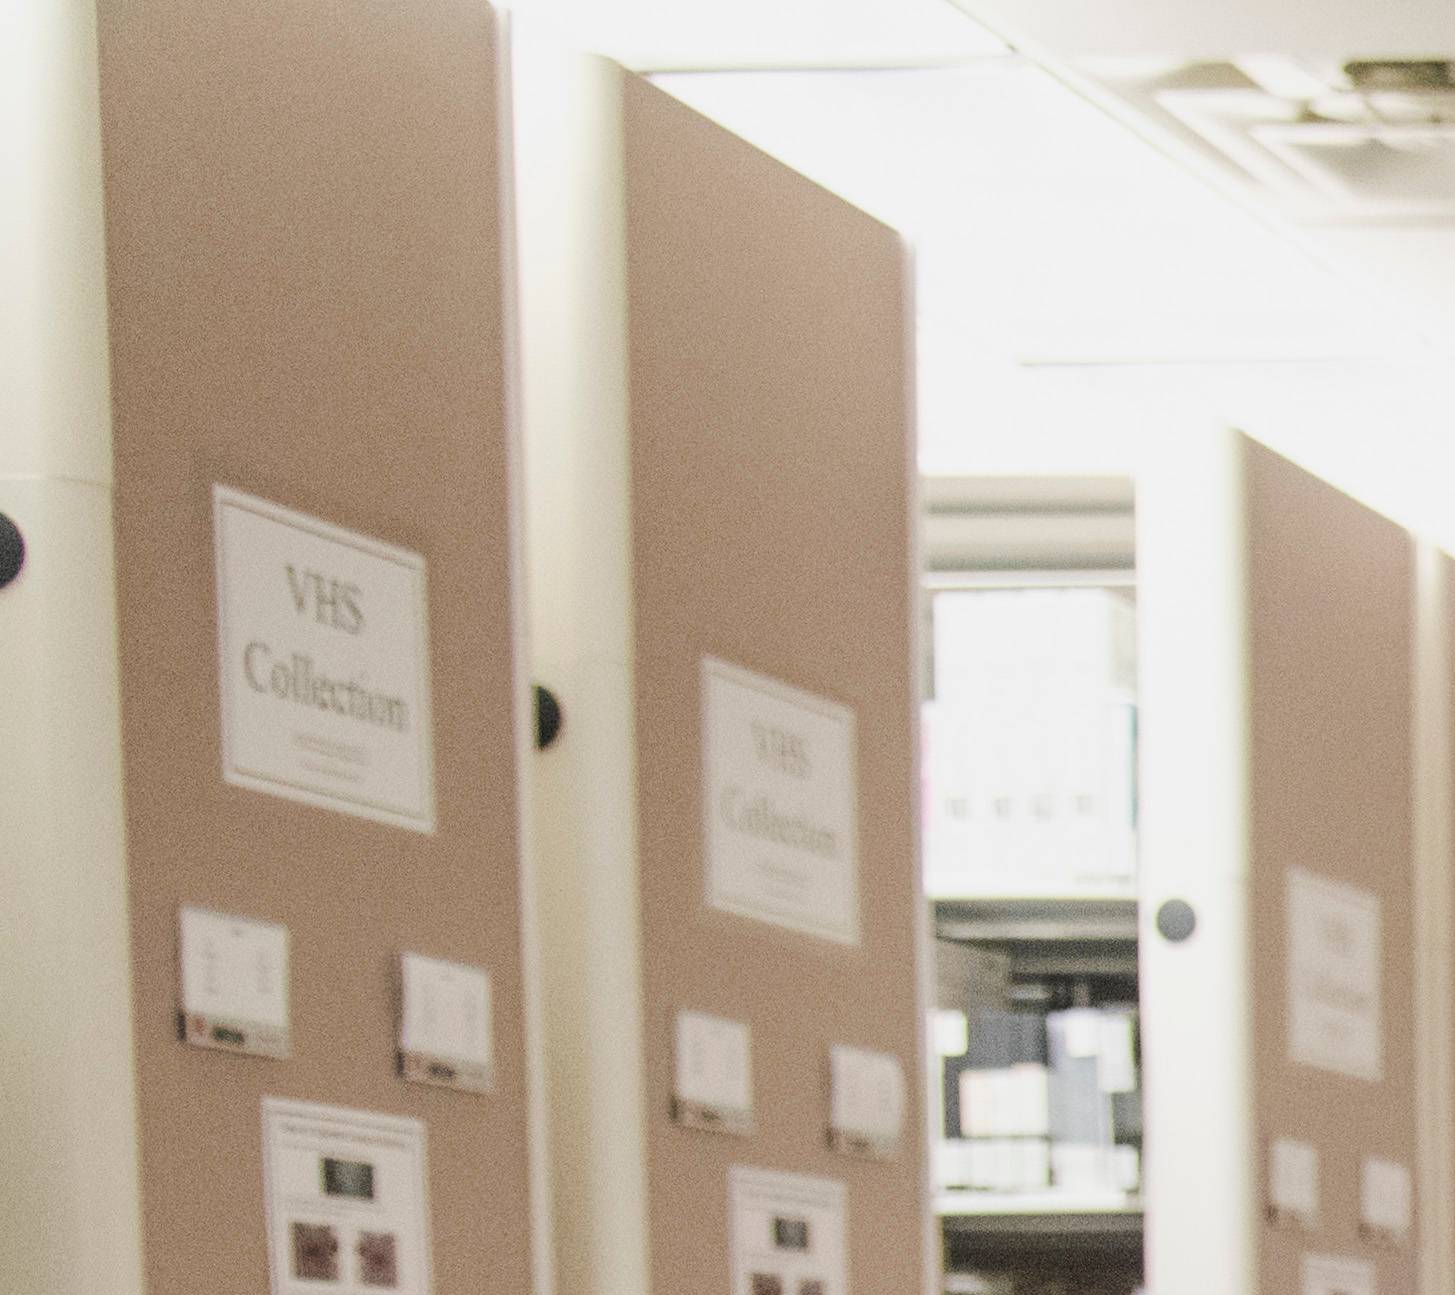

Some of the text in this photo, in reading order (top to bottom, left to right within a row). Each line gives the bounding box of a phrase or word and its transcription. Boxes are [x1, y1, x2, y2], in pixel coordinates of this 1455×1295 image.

[283, 562, 365, 637] VHS
[243, 640, 410, 733] Collection
[749, 721, 811, 777] VHS
[718, 784, 838, 862] Collection
